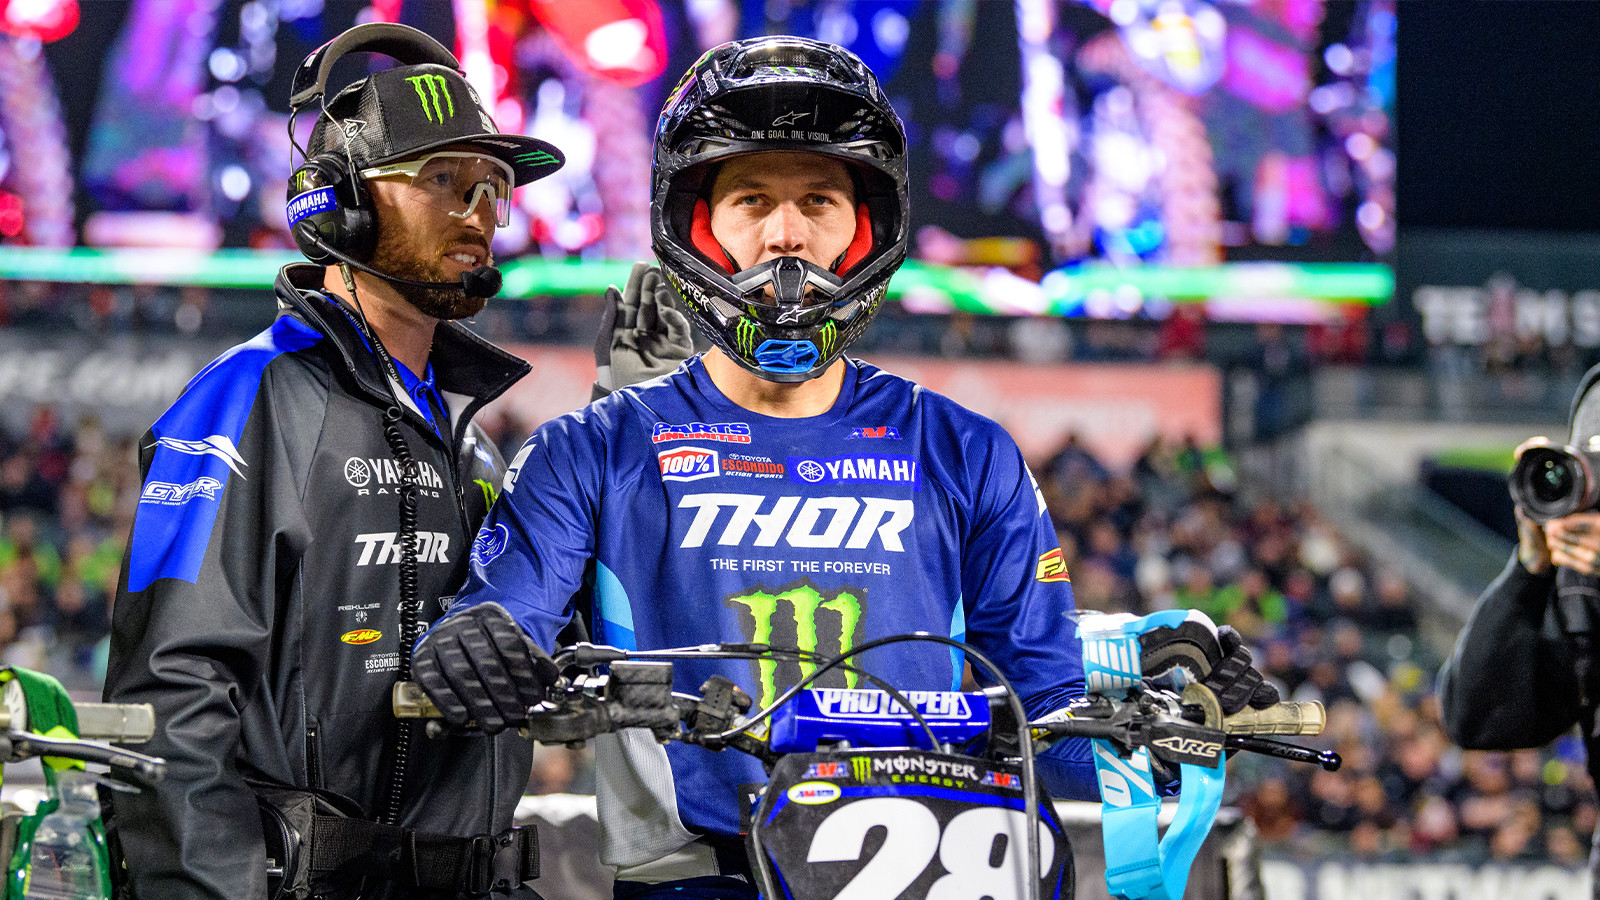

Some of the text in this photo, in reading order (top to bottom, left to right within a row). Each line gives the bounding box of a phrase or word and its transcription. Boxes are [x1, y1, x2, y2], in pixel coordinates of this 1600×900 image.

[751, 130, 765, 139] ONE
[768, 129, 789, 139] GOAL.
[791, 130, 804, 140] ONE
[292, 191, 329, 215] YAMAHA
[652, 422, 751, 438] PARTS
[652, 432, 752, 443] UNLIMITED
[845, 426, 902, 441] AMA
[661, 454, 711, 474] 100%
[721, 459, 785, 474] ESCONDIDO
[740, 455, 772, 463] TOYOTA
[368, 458, 444, 489] YAHA
[357, 488, 440, 499] RACNG
[678, 493, 914, 552] THOR
[354, 531, 450, 567] THOR
[710, 558, 891, 576] THE FIRST THE FOREVER
[338, 603, 380, 611] REKLUSE
[341, 631, 382, 642] FMF
[365, 657, 400, 669] ESCONDID
[1152, 736, 1223, 758] ARC
[801, 755, 1022, 790] AMA MONSTER AMA
[891, 774, 964, 789] ENERGY
[807, 797, 1055, 900] 28
